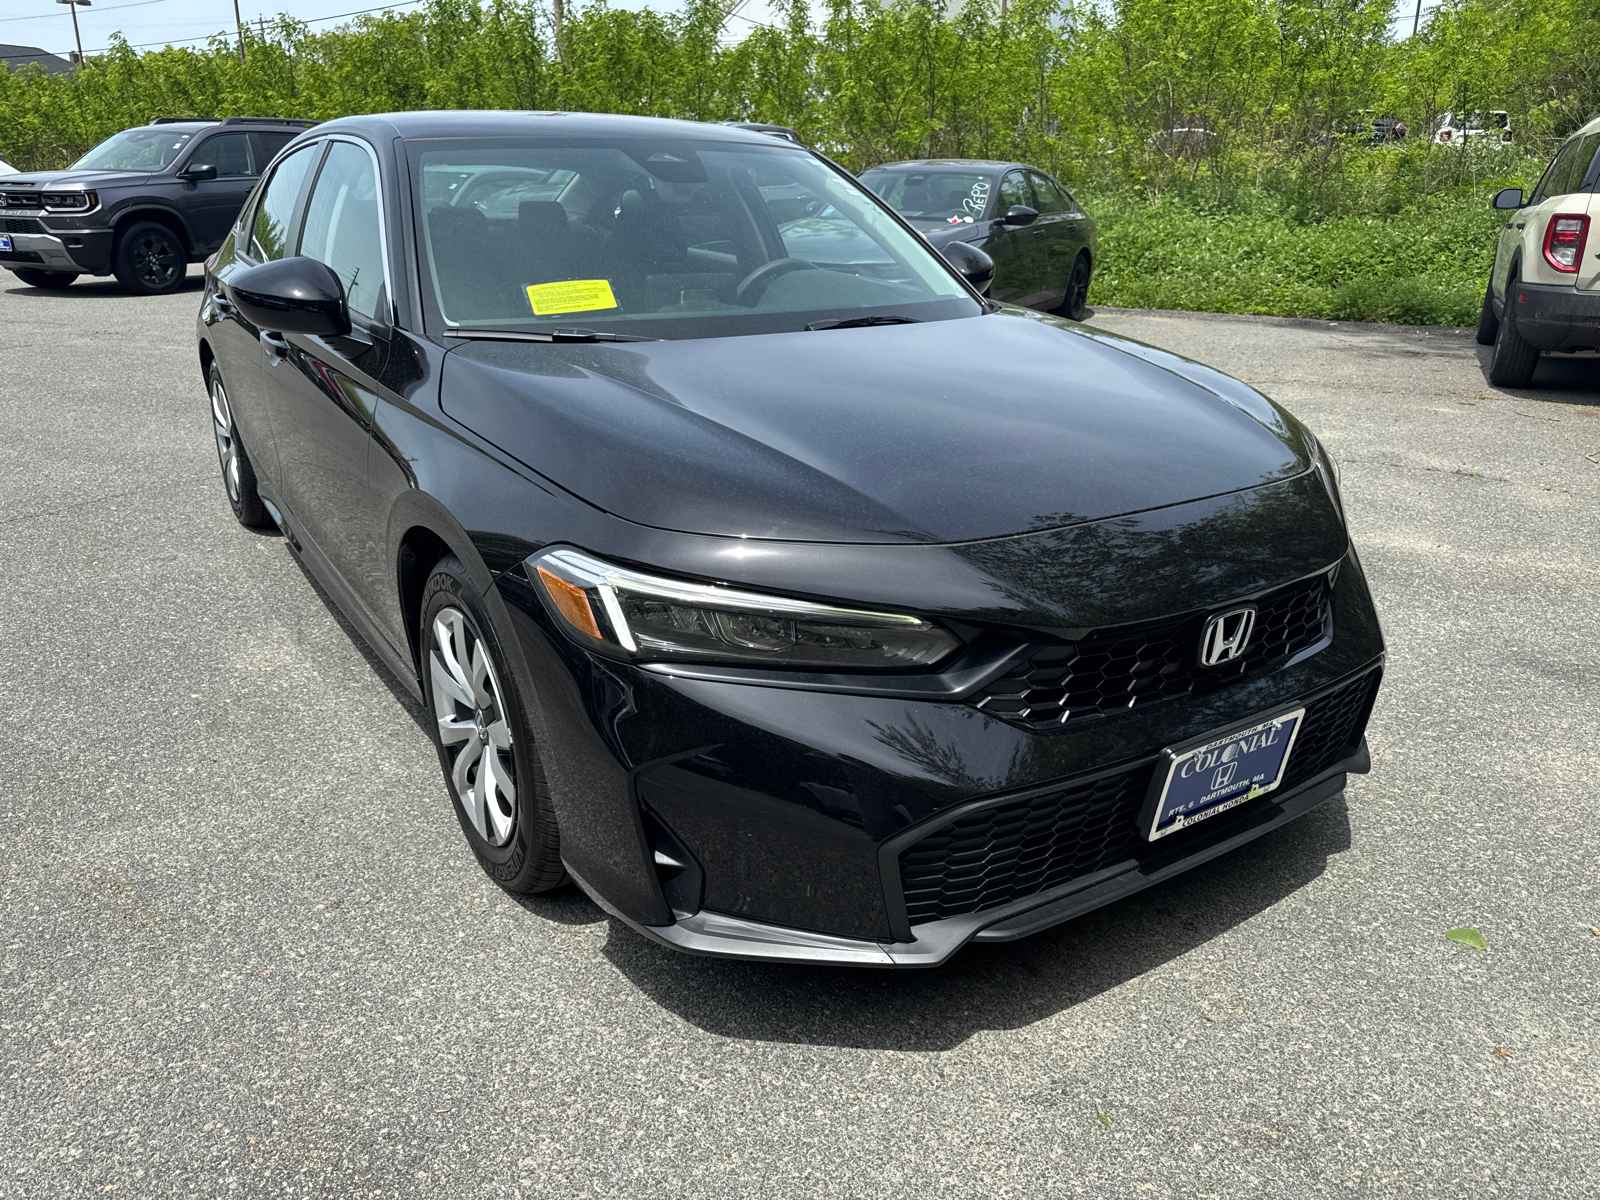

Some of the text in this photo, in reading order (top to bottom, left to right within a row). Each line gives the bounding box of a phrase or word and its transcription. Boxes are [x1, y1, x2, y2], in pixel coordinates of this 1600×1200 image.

[963, 182, 989, 212] REPO
[1181, 730, 1279, 779] COLONIAL
[1168, 804, 1186, 817] RTE.
[1188, 800, 1194, 808] 6
[1252, 773, 1265, 783] MA
[1182, 795, 1249, 827] COLONIAL HONDA
